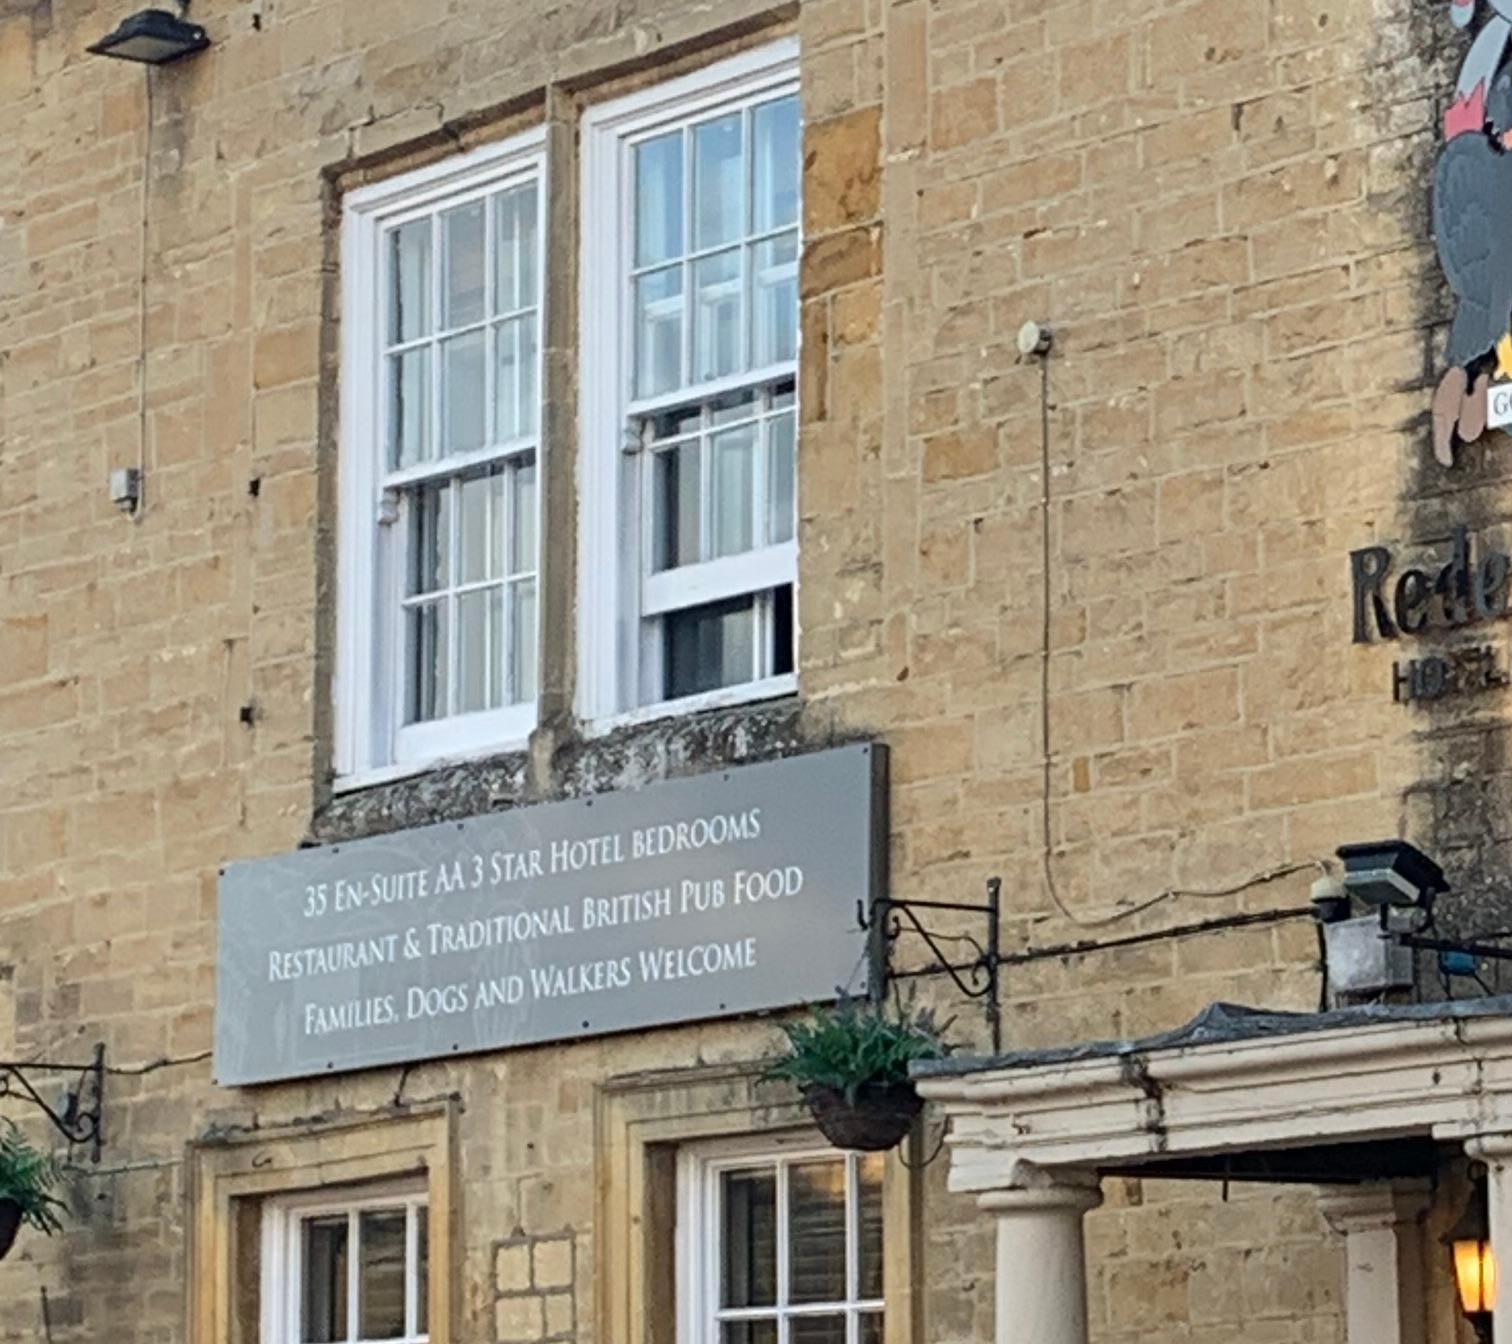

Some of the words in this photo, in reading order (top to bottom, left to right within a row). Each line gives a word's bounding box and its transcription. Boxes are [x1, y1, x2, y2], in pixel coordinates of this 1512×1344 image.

[304, 883, 328, 917] 35
[434, 860, 466, 895] AA
[470, 855, 484, 888] 3
[490, 849, 544, 886] STAR
[551, 834, 625, 873] HOTEL
[632, 807, 761, 860] BEDROOMS
[268, 934, 399, 982] RESTAURANT
[403, 927, 421, 960] &
[427, 905, 575, 955] TRADITIONAL
[582, 887, 672, 930] BRITISH
[680, 878, 725, 914] PUB
[734, 866, 804, 905] FOOD
[407, 982, 469, 1021] DOGS
[474, 974, 524, 1010] AND
[530, 956, 632, 1000] WALKERS
[638, 936, 757, 984] WELCOME
